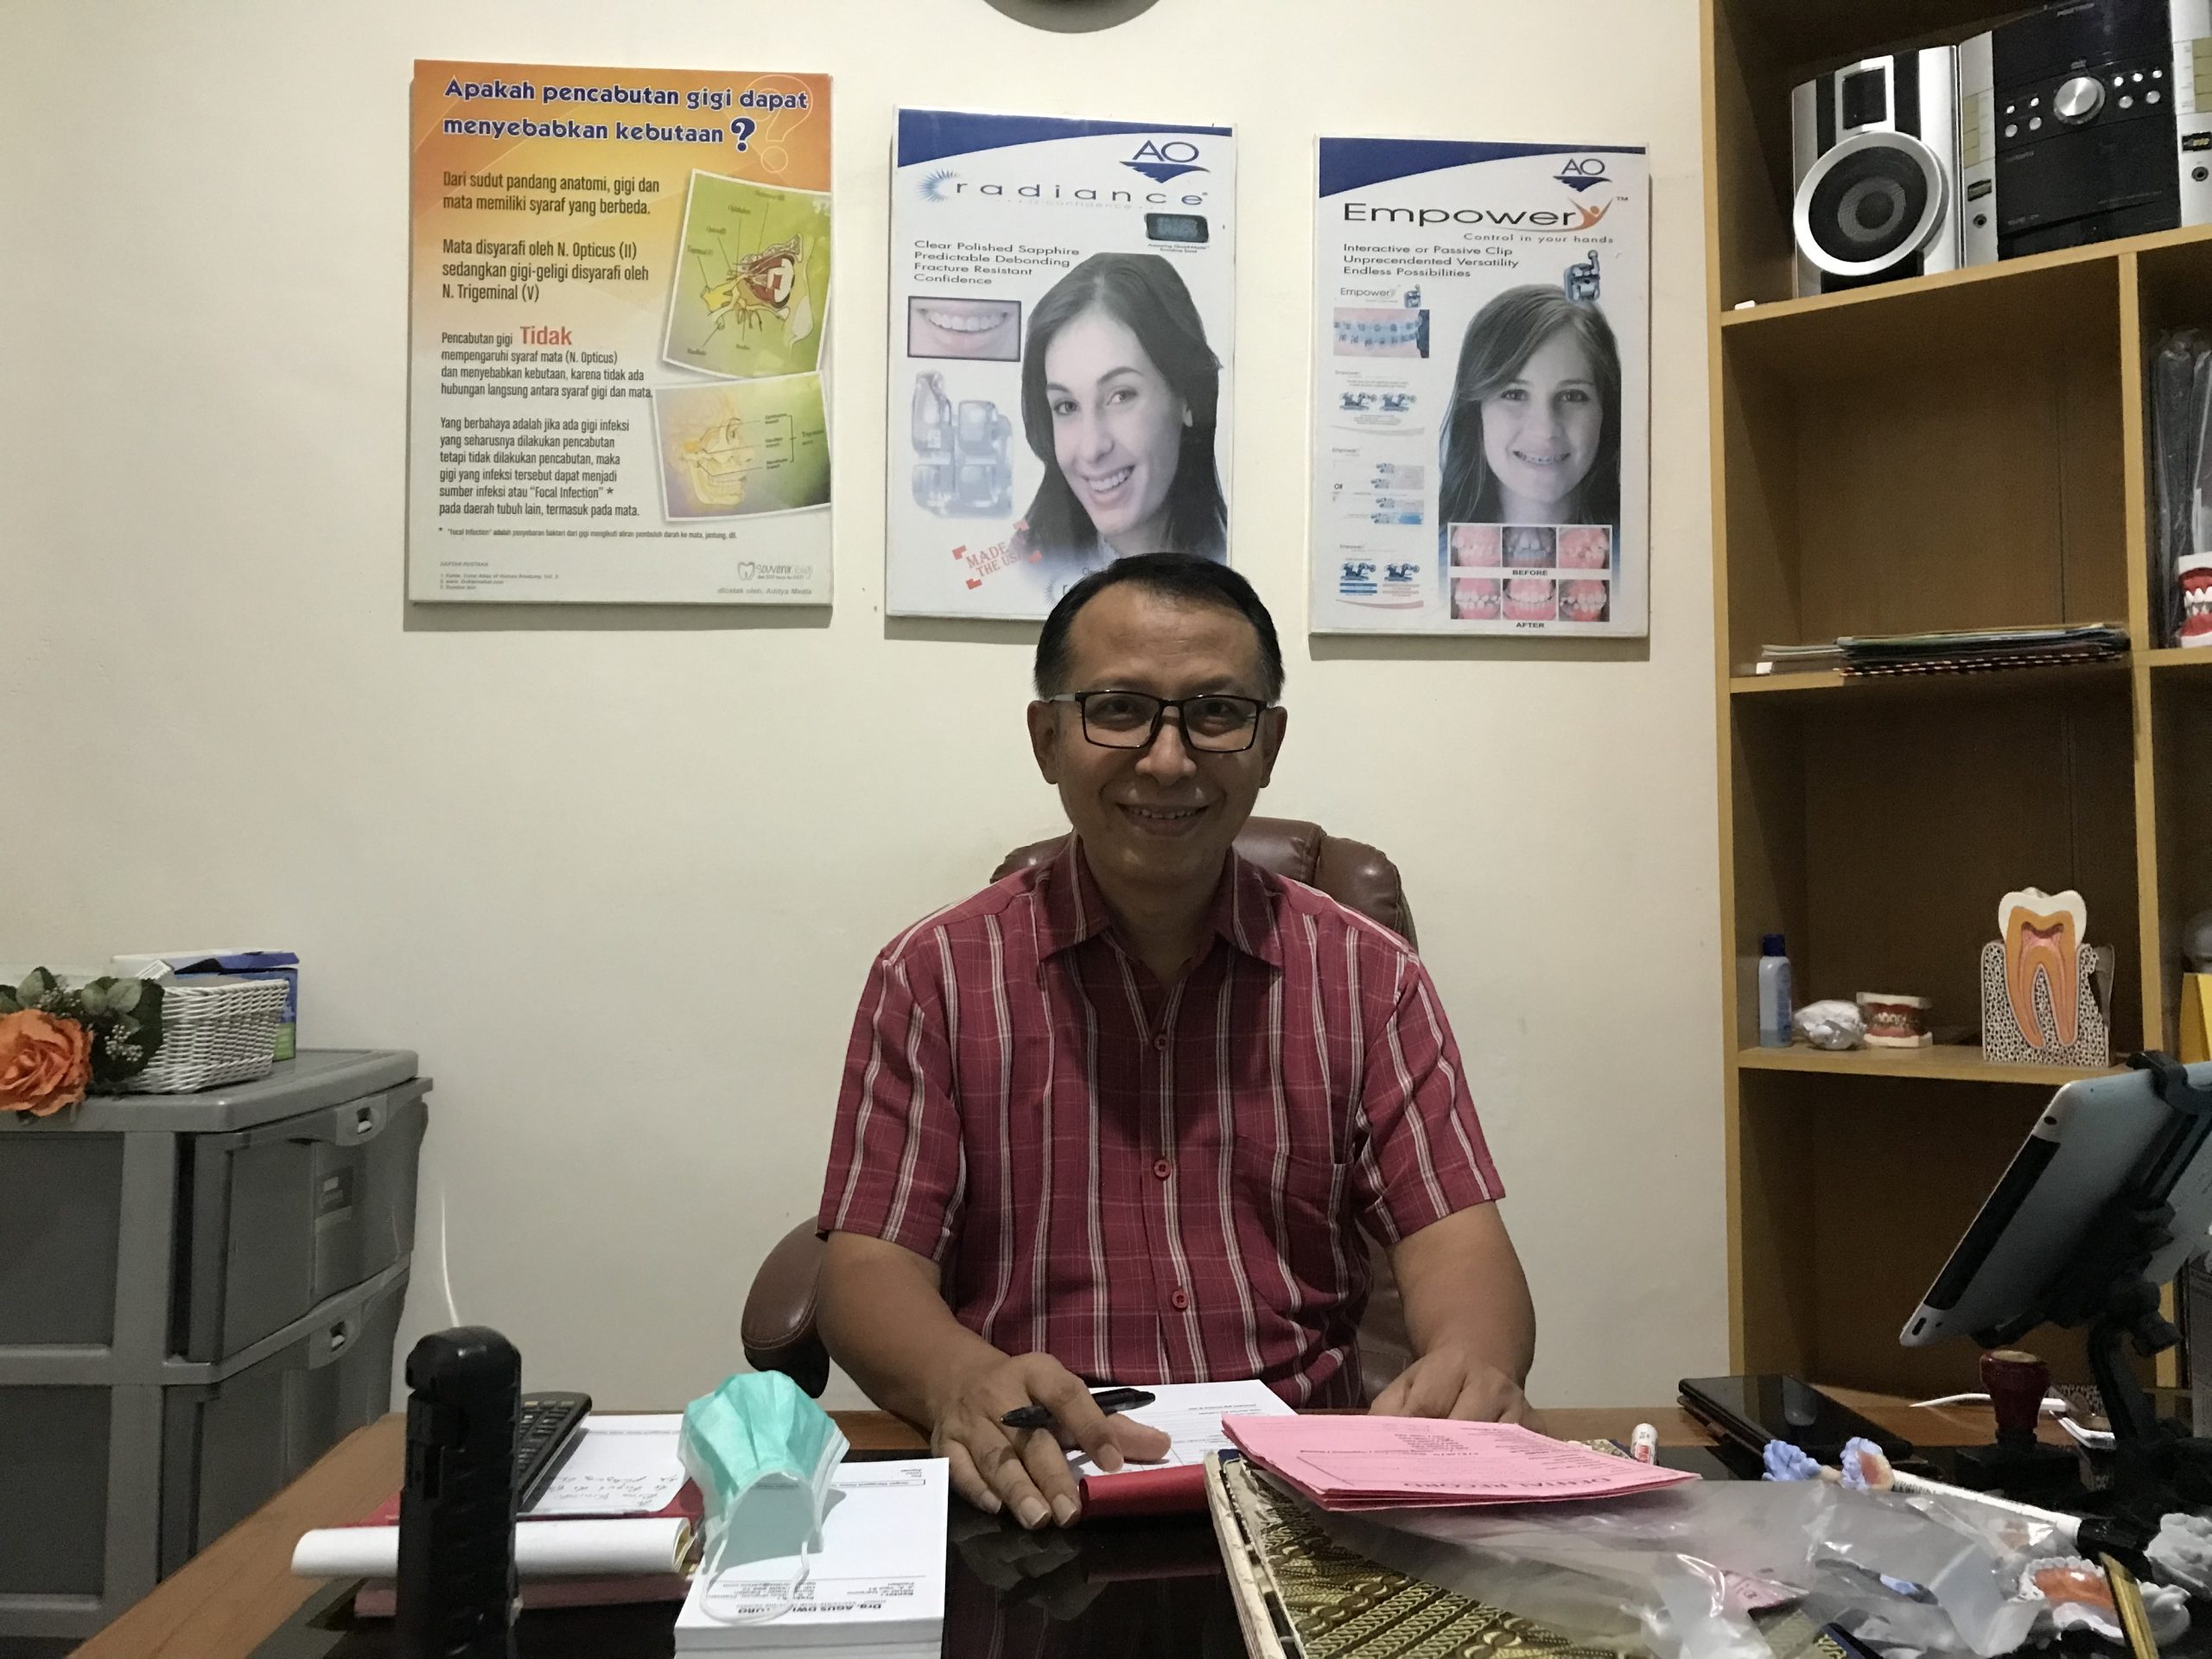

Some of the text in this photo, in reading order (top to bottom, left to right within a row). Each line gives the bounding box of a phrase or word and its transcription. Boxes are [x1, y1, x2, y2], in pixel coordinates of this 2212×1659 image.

[445, 79, 810, 112] Apakah pencabutan gigi dapat
[442, 117, 756, 152] menyebabkan kebutaan ?
[443, 172, 659, 194] Dari sudut pandang anatomi, gigi dan
[442, 195, 651, 217] mata memiliki syaraf yang berbeda.
[1344, 203, 1576, 226] Empower
[443, 238, 636, 260] Mata disyarafi oleh N. Opticus (II)
[914, 240, 1078, 256] Clear Polished Sapphire
[1344, 244, 1411, 254] Interactive
[1433, 245, 1480, 254] Passive
[1485, 246, 1512, 257] Clip
[914, 251, 1070, 268] Predictable Debonding
[1344, 255, 1518, 268] Unprecendented Versatility
[442, 262, 648, 283] sedangkan gigi-geligi disyarafi oleh
[914, 263, 1035, 275] Fracture Resistant
[1344, 266, 1470, 276] Endless Possibilities
[913, 274, 991, 284] Confidence
[442, 283, 539, 302] N. Trigeminal (V)
[442, 326, 572, 347] Pencabutan gigi Tidak
[441, 350, 617, 365] mempengaruhi syaraf mata (N. Opticus)
[441, 365, 644, 381] dan menyebabkan kebutaan, karena tidak ada
[441, 383, 485, 397] hubungan
[487, 384, 528, 398] langsung
[530, 385, 559, 397] antara
[561, 385, 588, 399] syaraf
[591, 385, 607, 400] gigi
[609, 385, 626, 397] dan
[441, 417, 629, 434] Yang berbahaya adalah jika ada gigi infeksi
[440, 435, 614, 449] yang seharusnya dilakukan pencabutan
[440, 451, 620, 466] tetapi tidak dilakukan pencabutan, maka
[440, 467, 616, 484] gigi yang infeksi tersebut dapat menjadi
[439, 486, 473, 497] sumber
[476, 486, 505, 497] infeksi
[507, 486, 527, 498] atau
[439, 502, 639, 518] pada daerah tubuh lain, termasuk pada mata.
[976, 559, 1001, 577] THE
